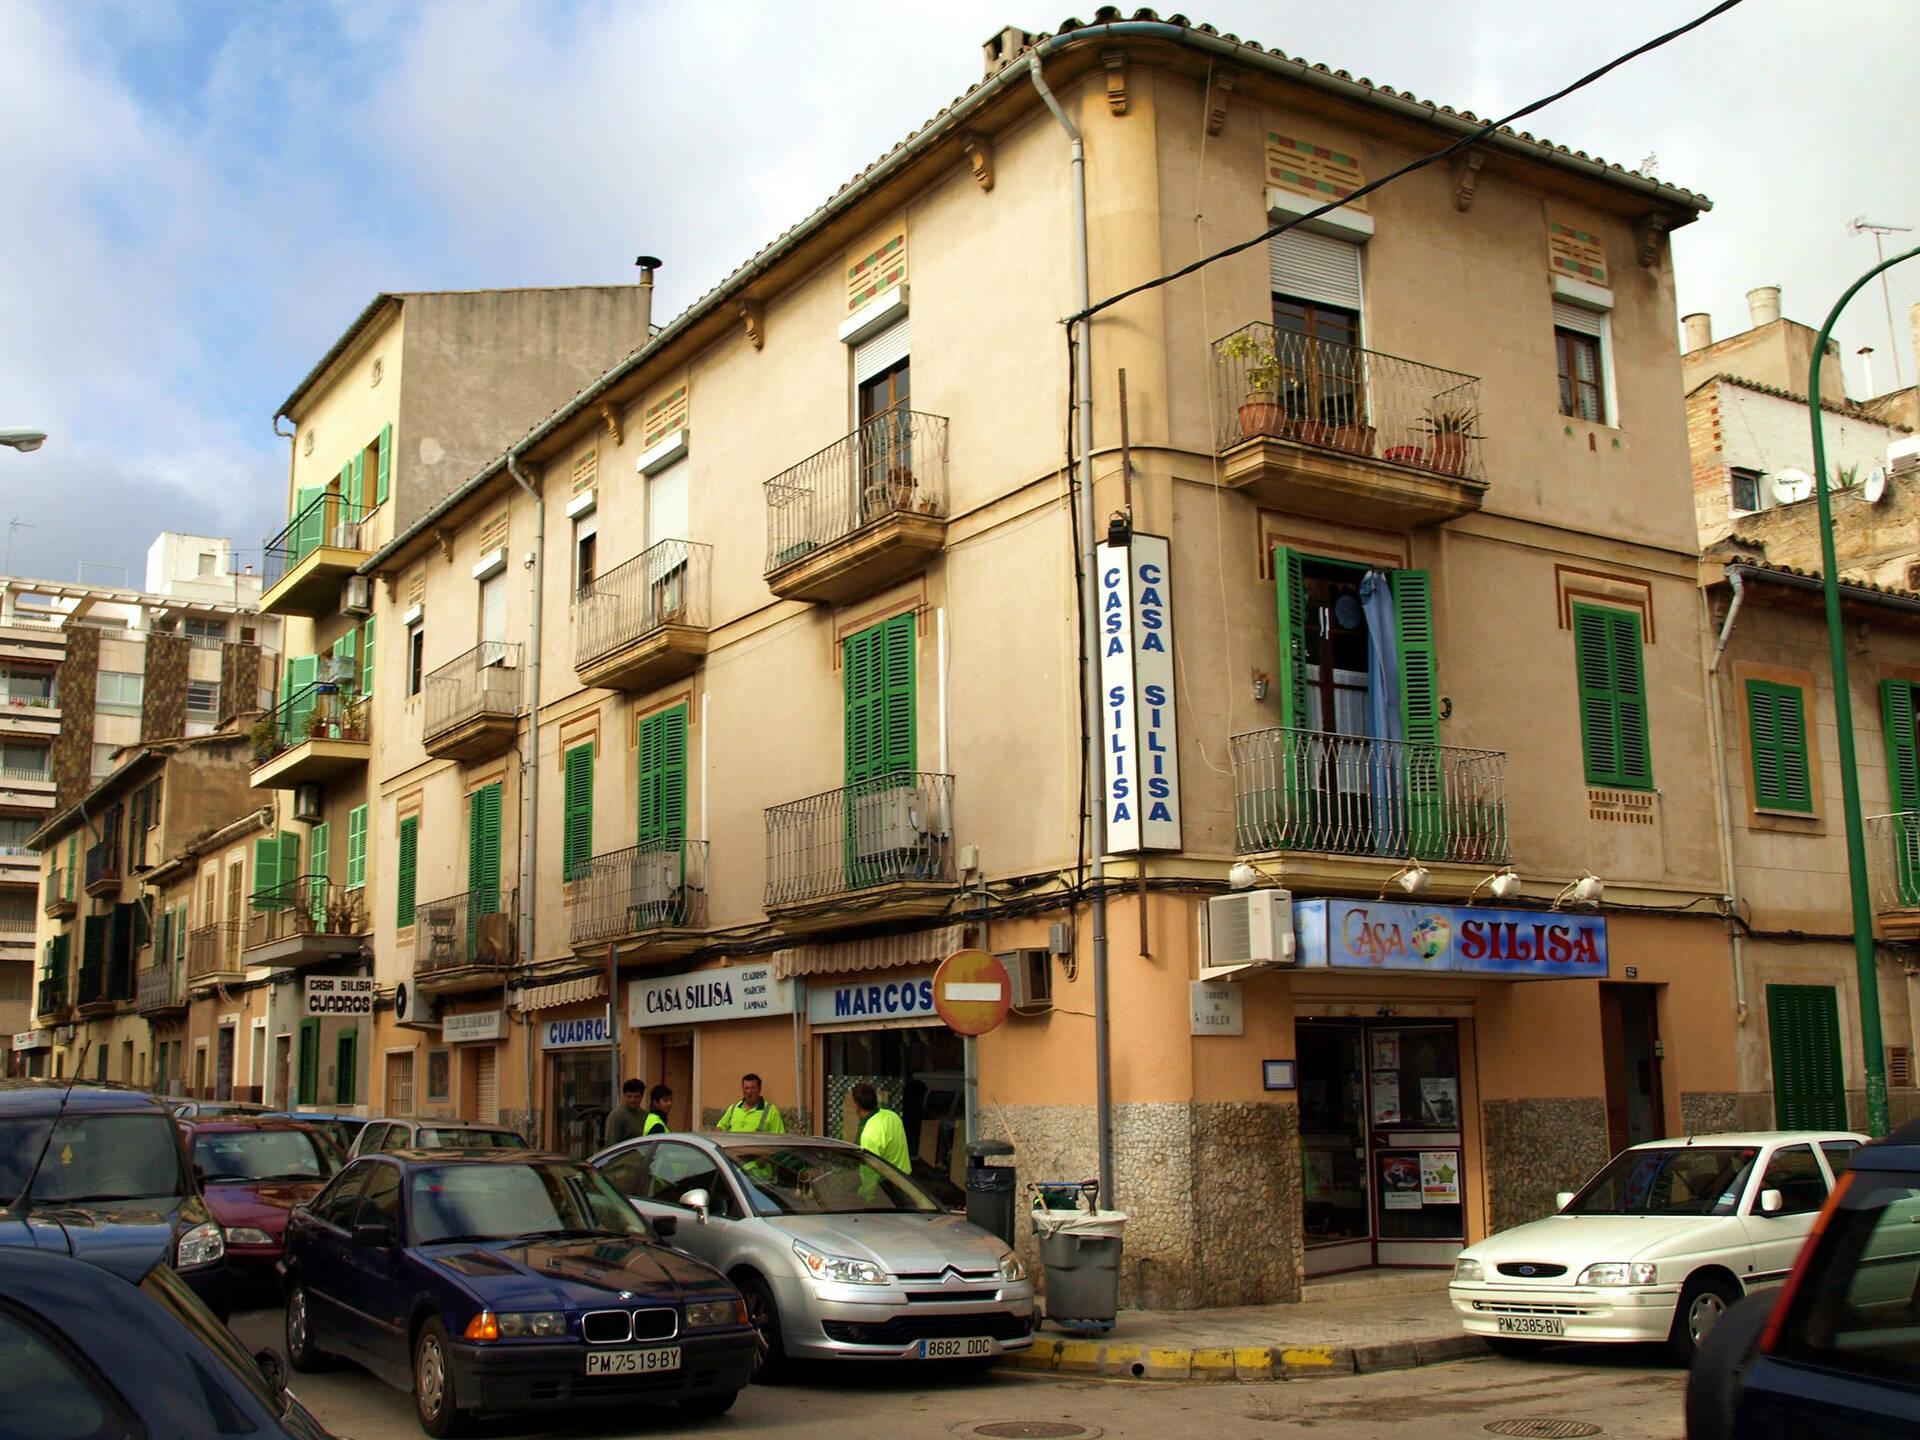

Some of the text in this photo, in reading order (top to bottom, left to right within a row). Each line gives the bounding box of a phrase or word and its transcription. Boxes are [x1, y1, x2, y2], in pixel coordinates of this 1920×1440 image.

[1104, 567, 1131, 823] CASA SILISA
[1139, 564, 1172, 822] CASA SILISA
[1341, 908, 1601, 964] CASA SILISA
[310, 980, 371, 992] CASA SILISA
[646, 980, 733, 1014] CASA SILISA
[835, 980, 933, 1017] MARCOS
[310, 995, 370, 1013] CUADROS
[929, 1339, 990, 1356] 8682 DDC
